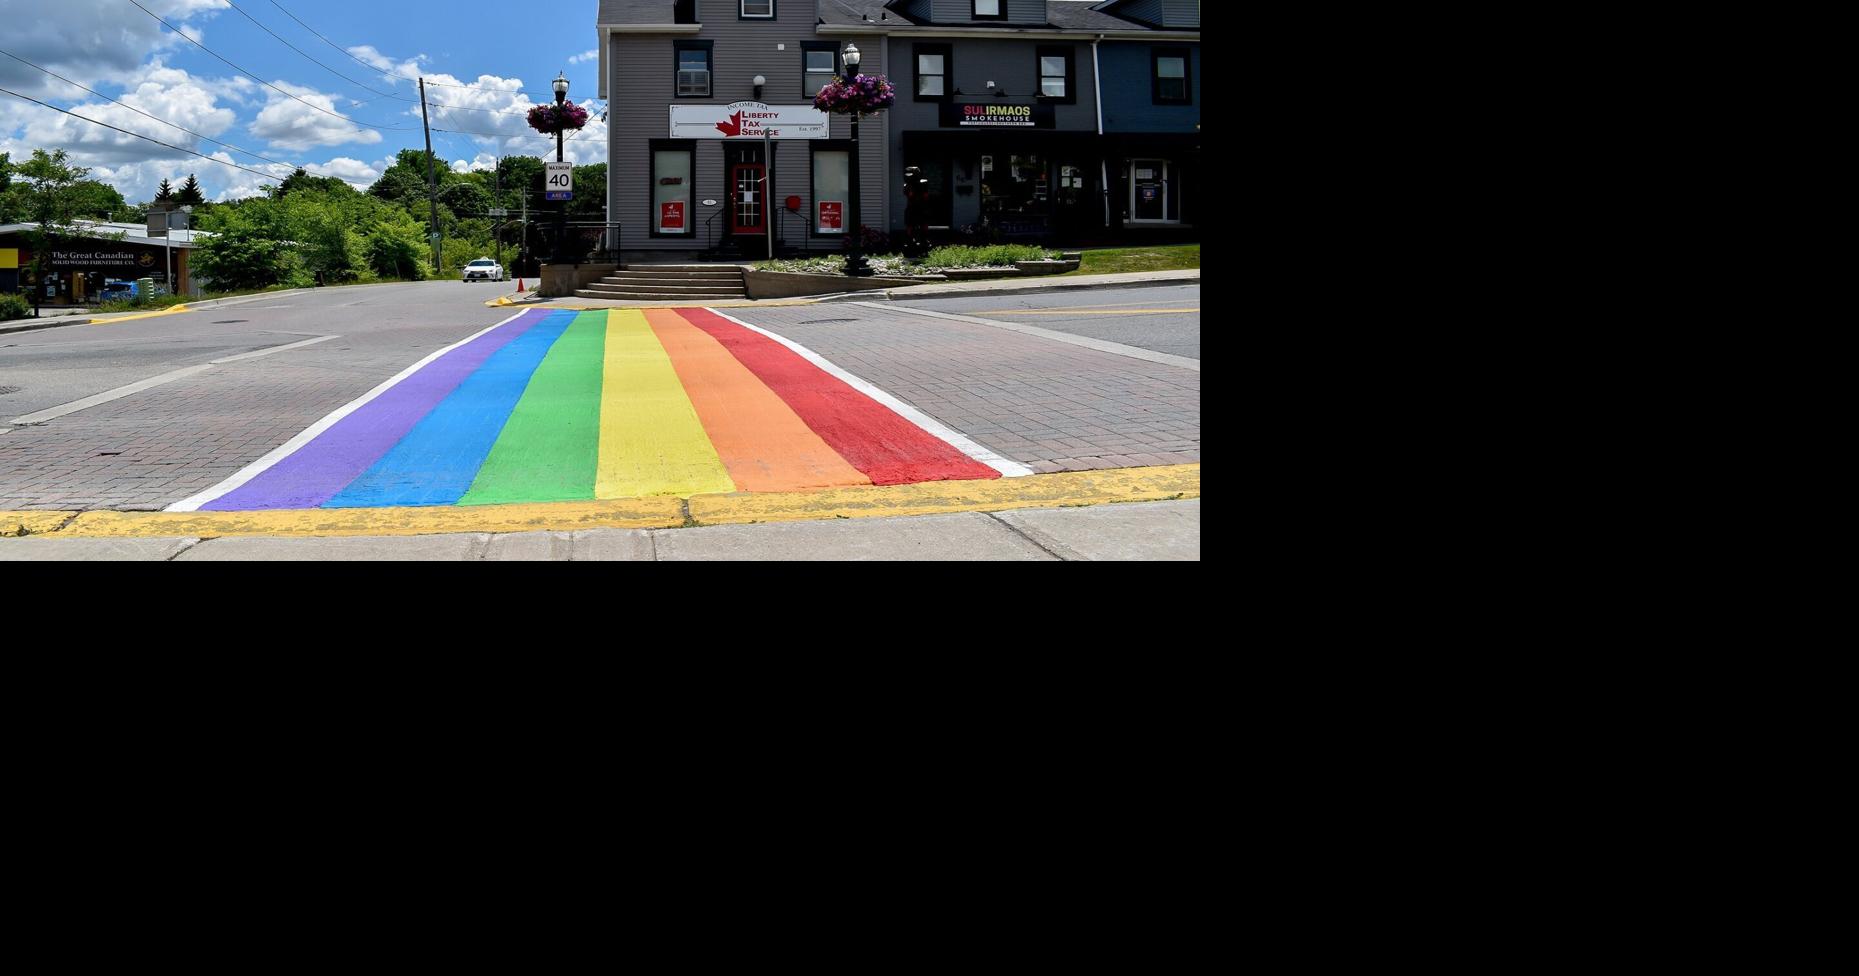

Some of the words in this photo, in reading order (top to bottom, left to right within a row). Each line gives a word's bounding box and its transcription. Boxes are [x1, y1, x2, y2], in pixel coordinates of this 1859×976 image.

[727, 102, 754, 111] INCOME
[756, 103, 769, 111] TAX
[964, 105, 1031, 116] SULIRMAOS
[742, 111, 779, 119] LIBERTY
[742, 128, 779, 136] SERVCE
[549, 174, 569, 187] 40
[52, 251, 68, 259] The
